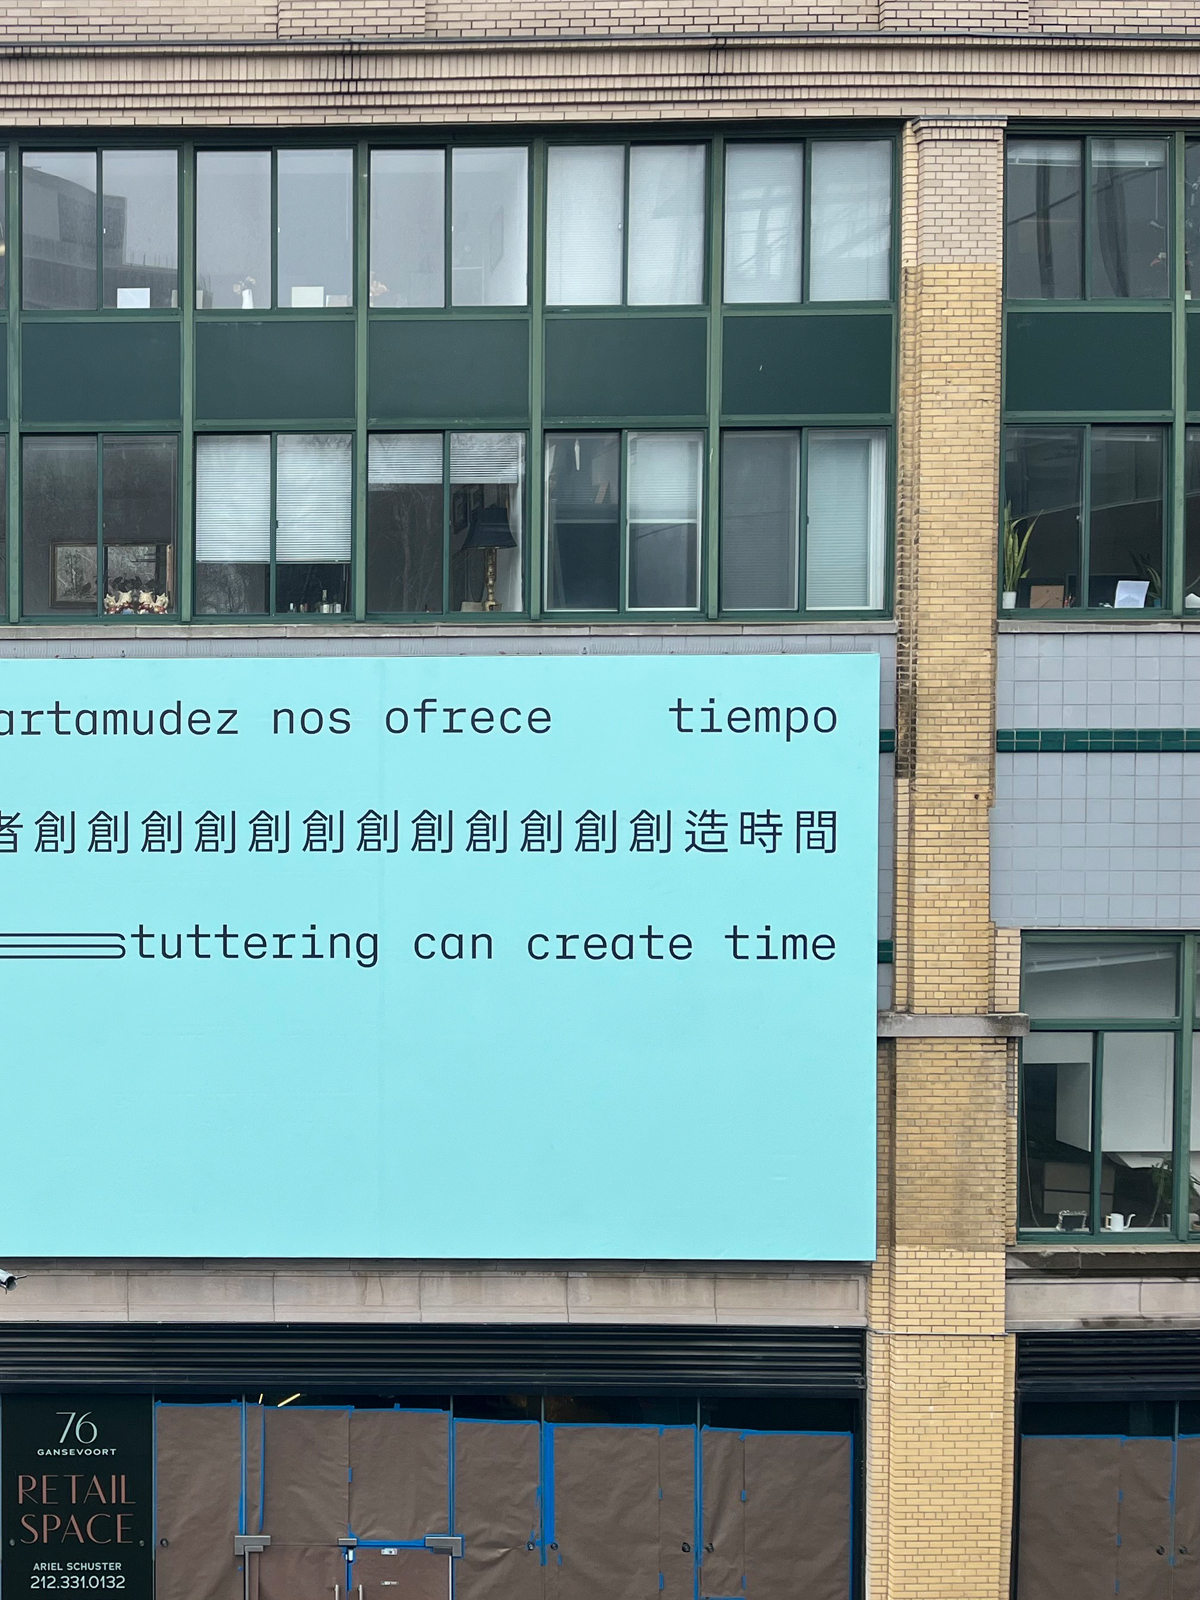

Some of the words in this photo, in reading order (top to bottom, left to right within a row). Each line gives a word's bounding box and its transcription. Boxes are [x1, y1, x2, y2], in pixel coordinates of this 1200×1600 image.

[273, 707, 351, 735] nos
[385, 698, 552, 734] ofrece
[668, 697, 837, 743] tiempo
[414, 933, 493, 960] can
[527, 924, 693, 961] create
[724, 924, 836, 961] time
[55, 1411, 98, 1445] 76
[36, 1448, 117, 1456] GANSEVOORT
[17, 1474, 137, 1505] RETAIL
[20, 1513, 134, 1545] SPACE
[30, 1575, 126, 1589] 212.331.0132
[33, 1562, 63, 1571] ARIEL
[66, 1562, 122, 1571] SCHUSTER
